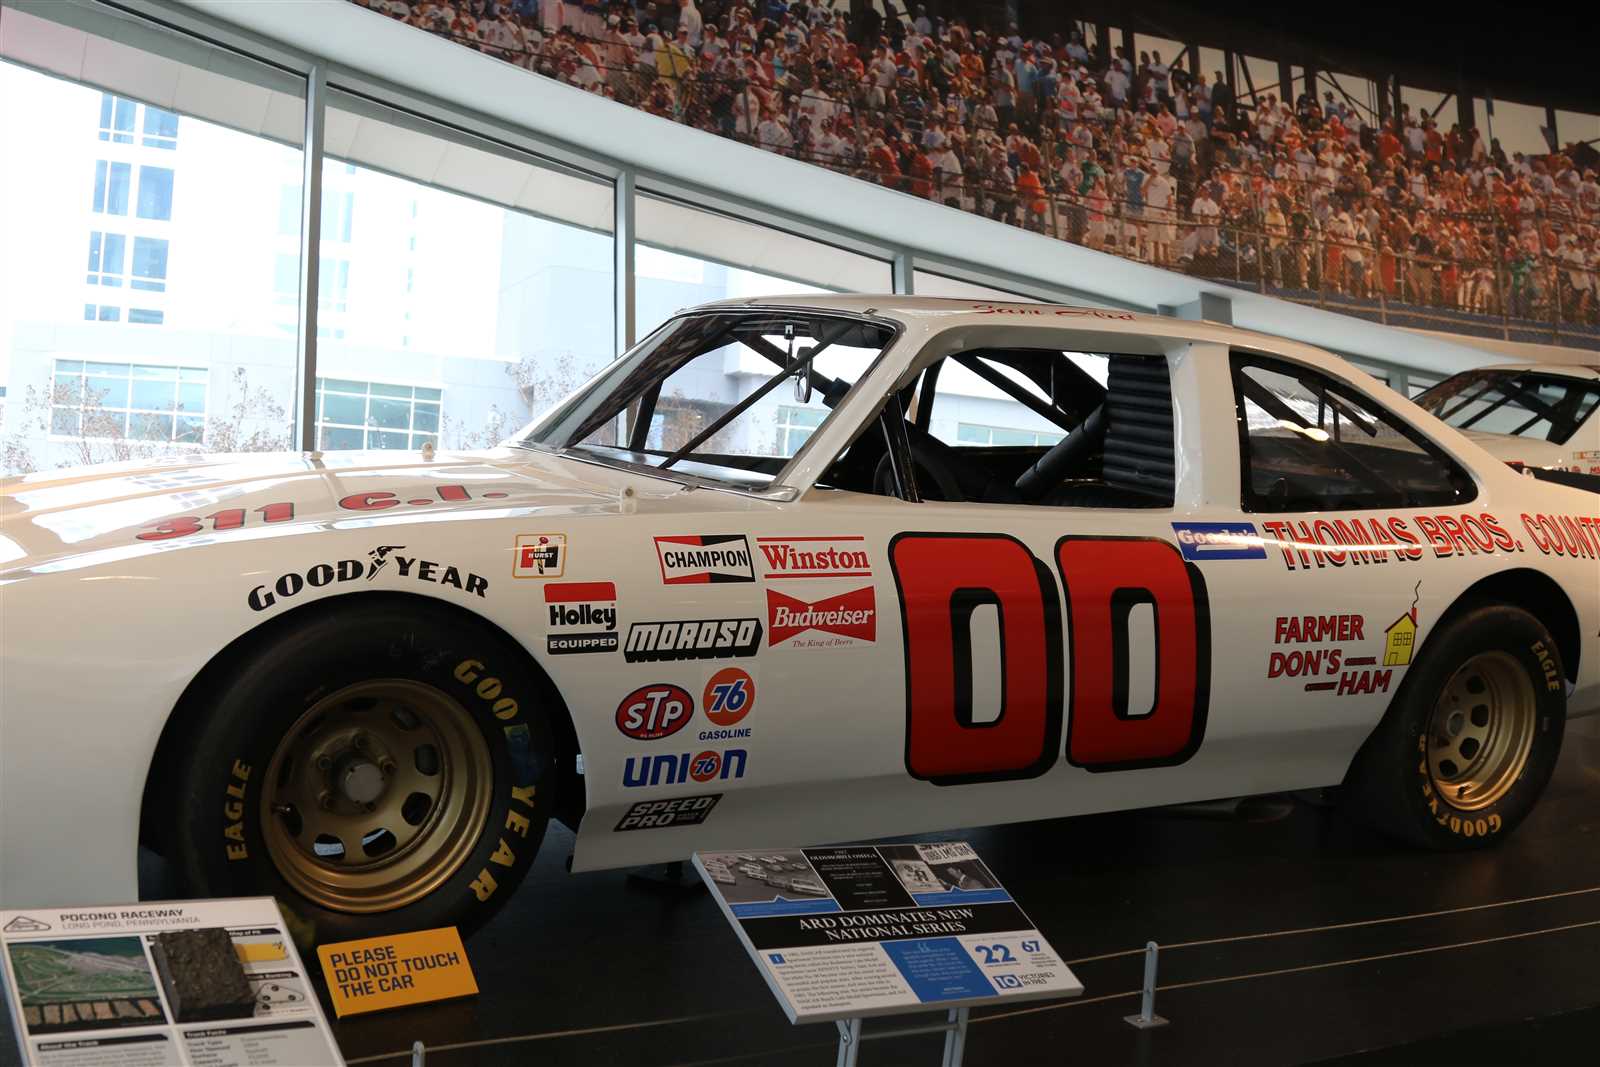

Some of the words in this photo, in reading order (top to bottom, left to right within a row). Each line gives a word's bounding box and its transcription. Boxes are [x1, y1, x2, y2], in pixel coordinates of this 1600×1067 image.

[135, 502, 295, 541] 311
[1262, 516, 1424, 571] THOMAS
[1413, 512, 1525, 559] BROS.
[527, 552, 554, 560] HURST
[664, 550, 749, 569] CHAMPION
[758, 544, 870, 571] Winston
[549, 603, 617, 631] Holley
[772, 605, 875, 628] Budweiser
[625, 619, 760, 658] MOROSO
[1274, 614, 1365, 644] FARMER
[549, 638, 617, 649] EQUIPPED
[792, 640, 804, 648] The
[807, 639, 823, 648] King
[888, 531, 1212, 786] 00
[1267, 649, 1342, 678] DON'S
[1531, 640, 1560, 691] EAGLE
[1336, 670, 1393, 696] HAM
[709, 679, 748, 713] 76
[624, 691, 684, 731] STP
[698, 728, 752, 741] GASOLINE
[226, 759, 253, 861] EAGLE
[630, 797, 713, 817] SPEED
[620, 813, 676, 829] PRO
[60, 911, 117, 922] POCONO
[120, 909, 183, 920] RACEWAY
[800, 917, 836, 930] ARD
[838, 910, 938, 928] DOMINATES
[937, 908, 974, 922] NEW
[825, 924, 913, 941] NATIONAL
[912, 921, 967, 934] SERIES
[331, 945, 396, 968] PLEASE
[975, 944, 1017, 964] 22
[1021, 940, 1041, 953] 67
[336, 967, 361, 983] DO
[365, 960, 400, 979] NOT
[401, 952, 460, 972] TOUCH
[339, 980, 375, 999] THE
[378, 975, 415, 992] CAR
